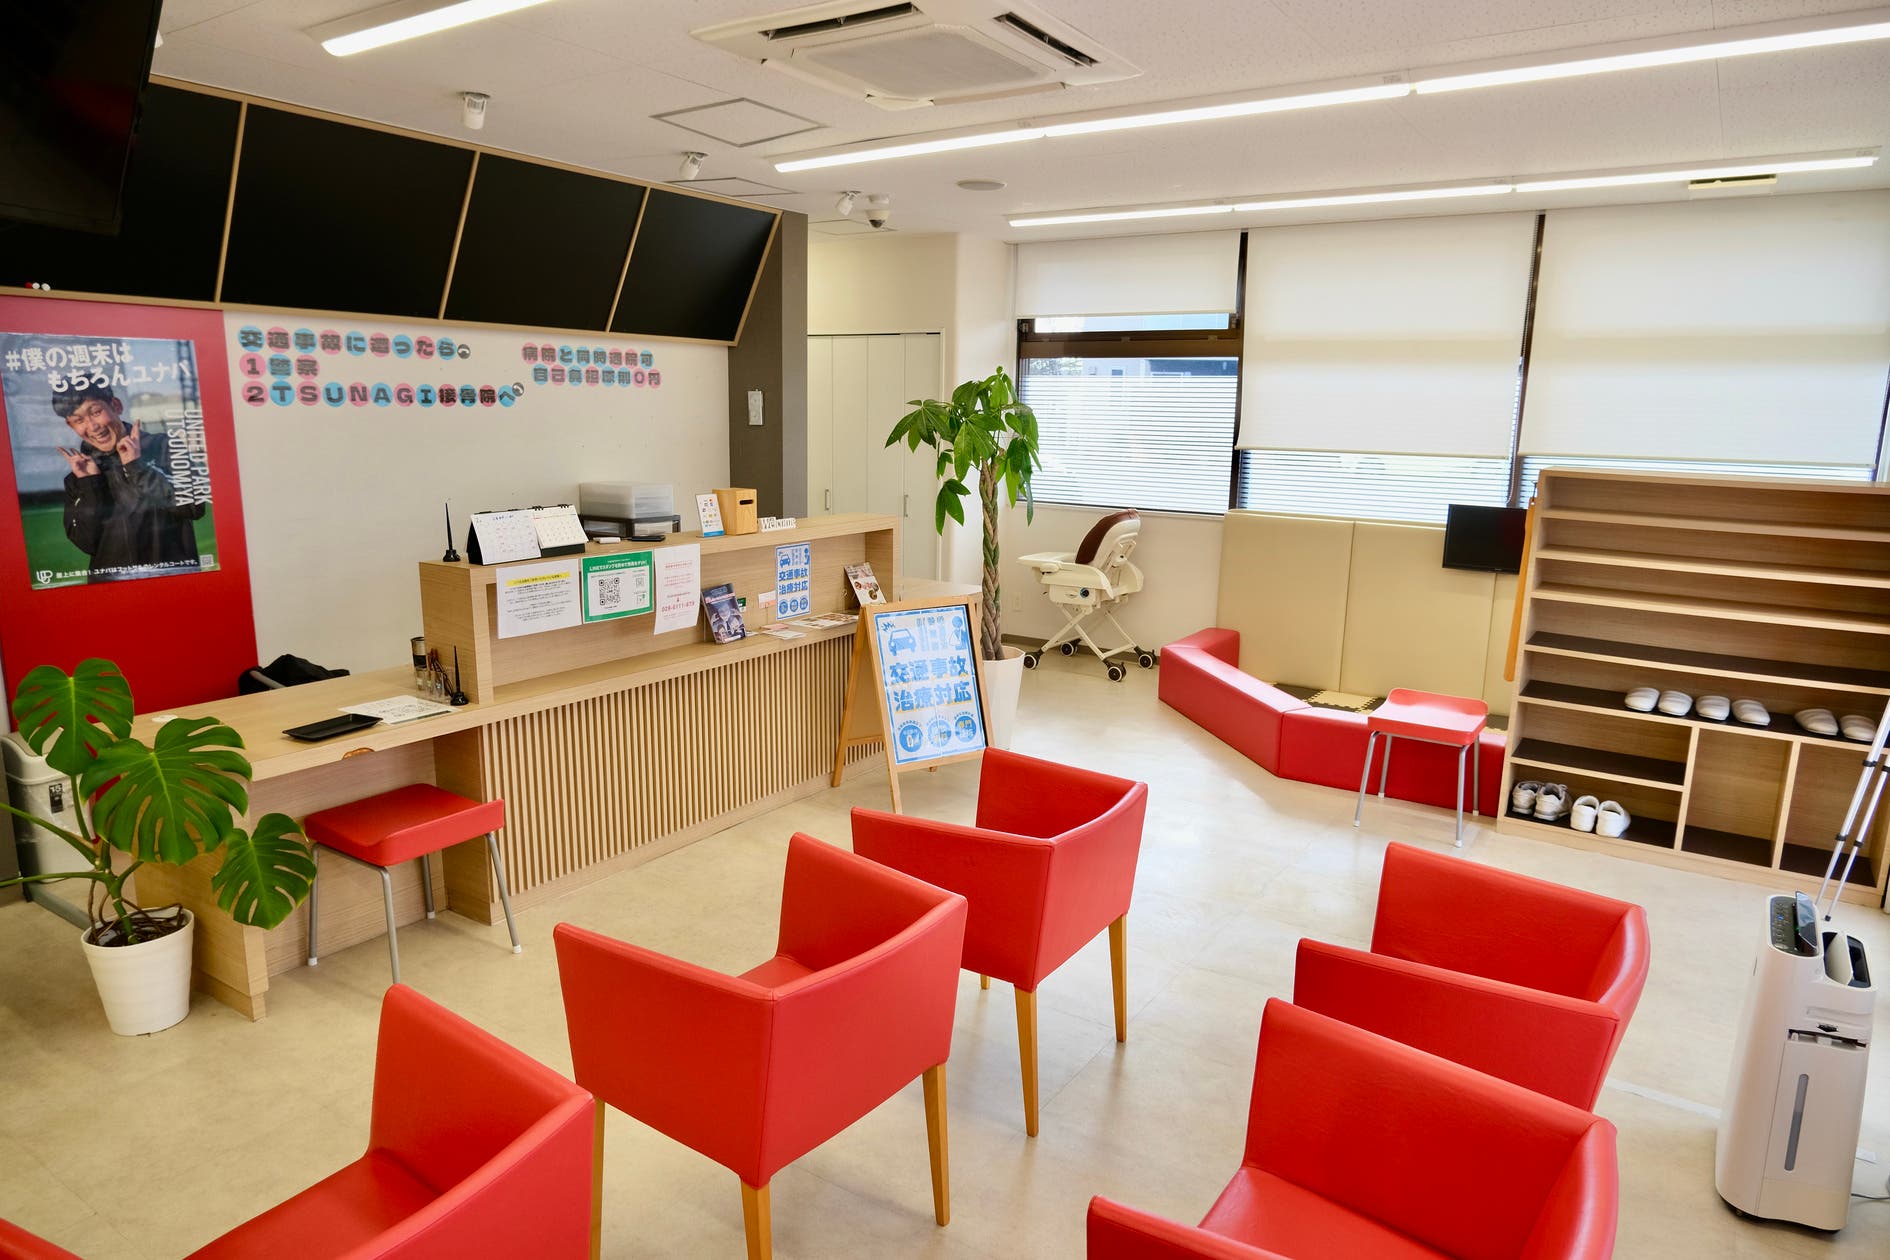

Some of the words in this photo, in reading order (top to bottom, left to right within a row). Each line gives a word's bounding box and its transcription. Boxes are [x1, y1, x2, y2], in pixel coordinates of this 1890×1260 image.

[5, 342, 134, 372] #僕の週末は
[184, 409, 208, 463] UNITED
[165, 409, 195, 507] UTSUNOMIYA
[190, 466, 213, 506] PARK
[778, 568, 808, 582] 交通事故
[778, 581, 808, 595] 治療対応
[889, 655, 969, 685] 交通事故
[893, 680, 972, 712] 治療対応
